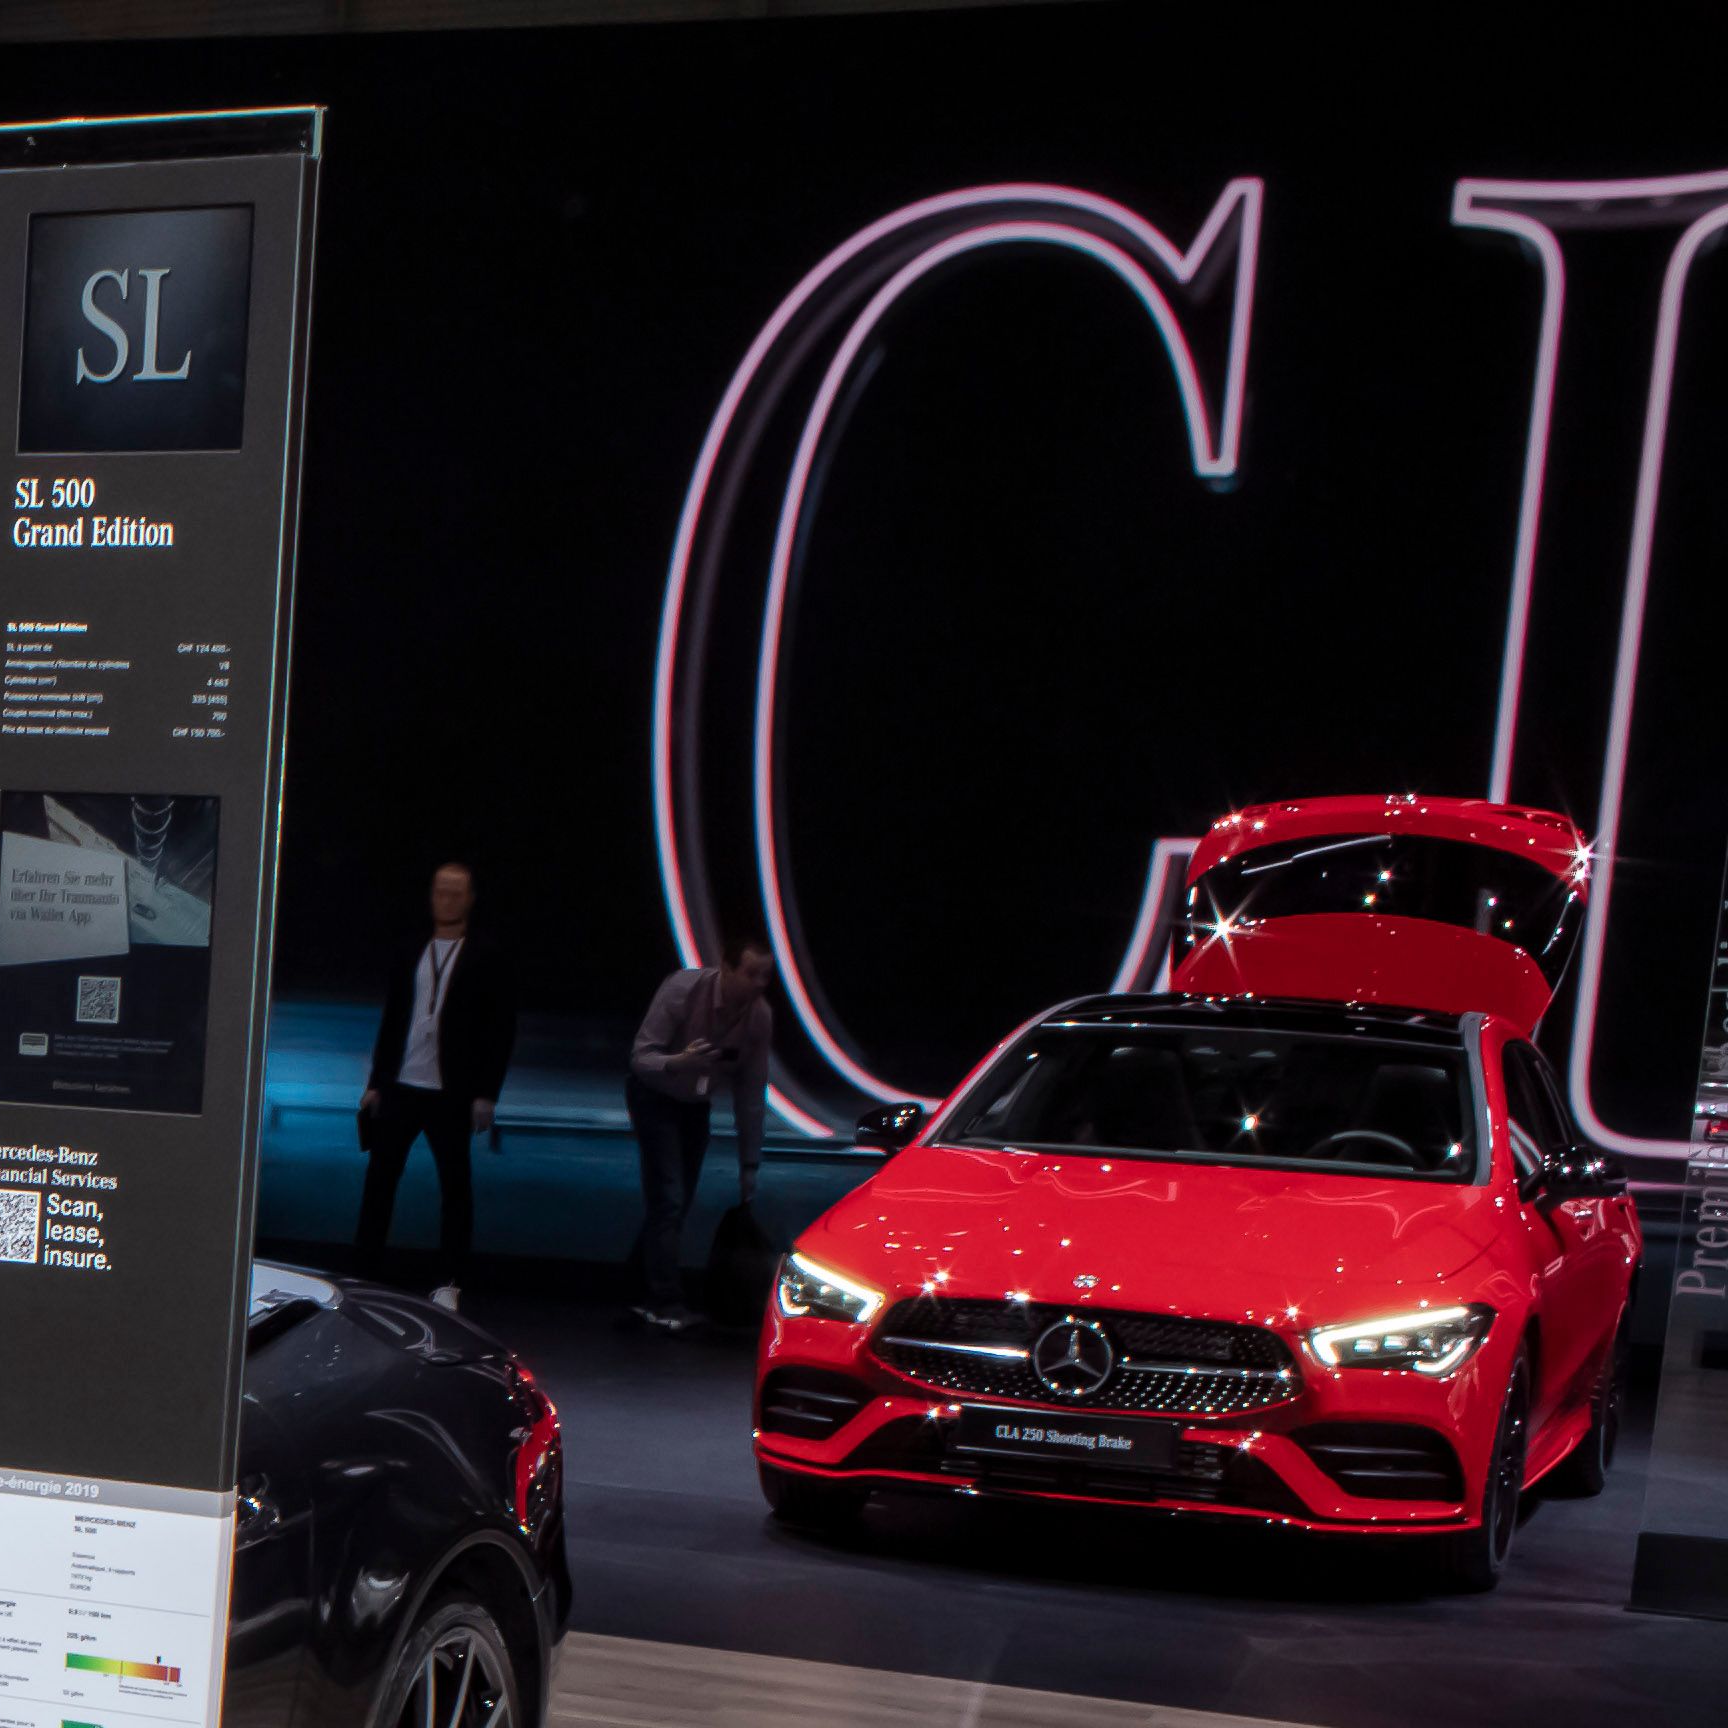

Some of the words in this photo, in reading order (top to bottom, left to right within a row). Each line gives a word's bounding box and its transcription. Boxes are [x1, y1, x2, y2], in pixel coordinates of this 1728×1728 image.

[76, 267, 192, 386] SL
[14, 478, 44, 509] SL
[51, 477, 96, 508] 500
[13, 517, 84, 547] Grand
[91, 516, 174, 548] Edition
[64, 871, 81, 885] Sie
[84, 871, 114, 887] mehr
[51, 1169, 118, 1191] Services
[46, 1192, 104, 1222] Scan,
[45, 1219, 105, 1248] lease,
[43, 1244, 112, 1271] insure.
[995, 1424, 1020, 1440] CLA
[1022, 1426, 1044, 1441] 250
[1046, 1428, 1096, 1449] Shooting
[1098, 1434, 1132, 1449] Brake
[64, 1481, 100, 1498] 2019
